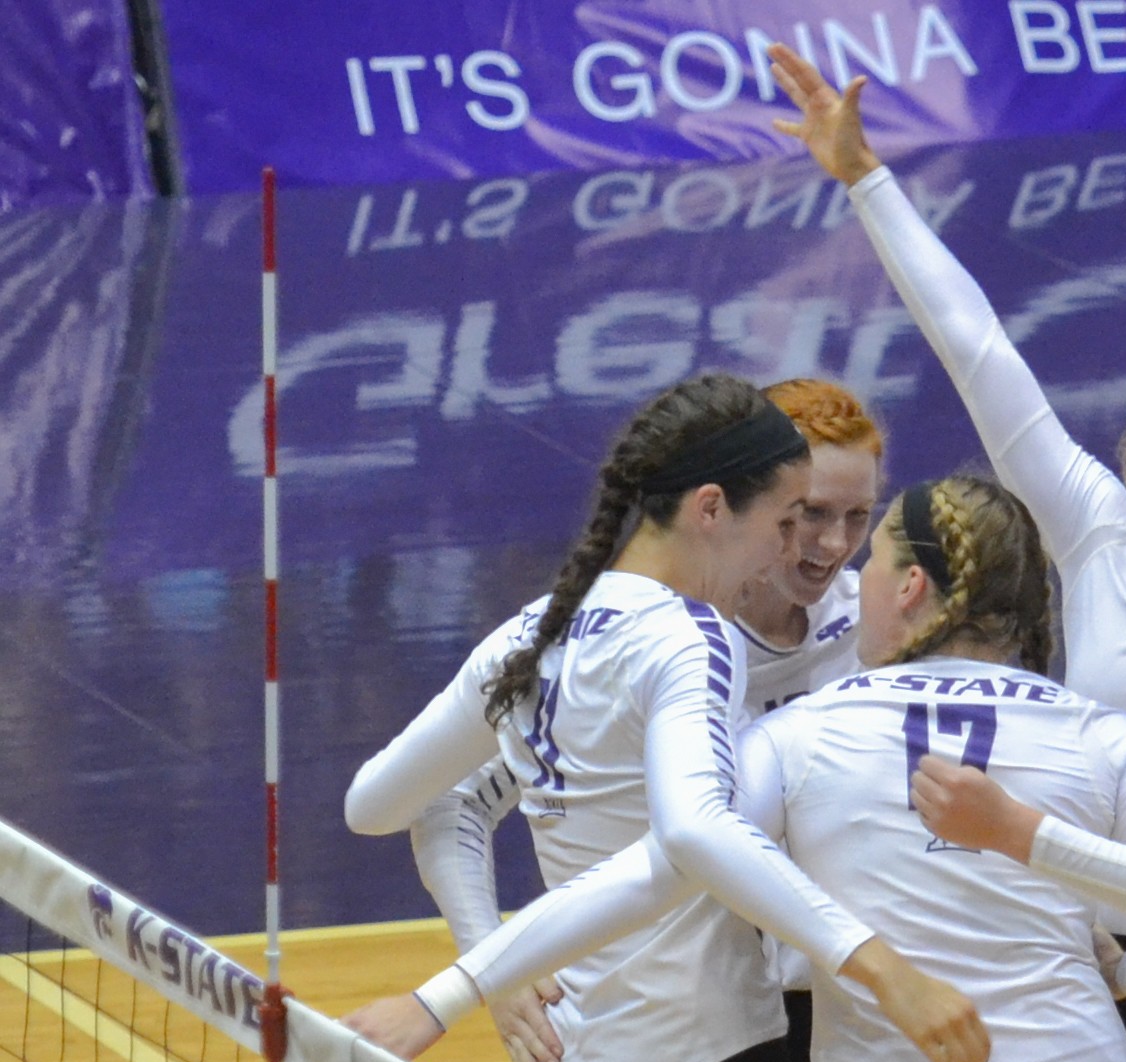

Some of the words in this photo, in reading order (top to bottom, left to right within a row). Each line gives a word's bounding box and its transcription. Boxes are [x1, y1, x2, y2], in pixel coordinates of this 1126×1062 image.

[345, 50, 531, 136] IT'S
[572, 6, 979, 121] GONNA
[836, 673, 1064, 704] K-STATE
[901, 703, 998, 811] 17
[126, 906, 265, 1028] K-STATE
